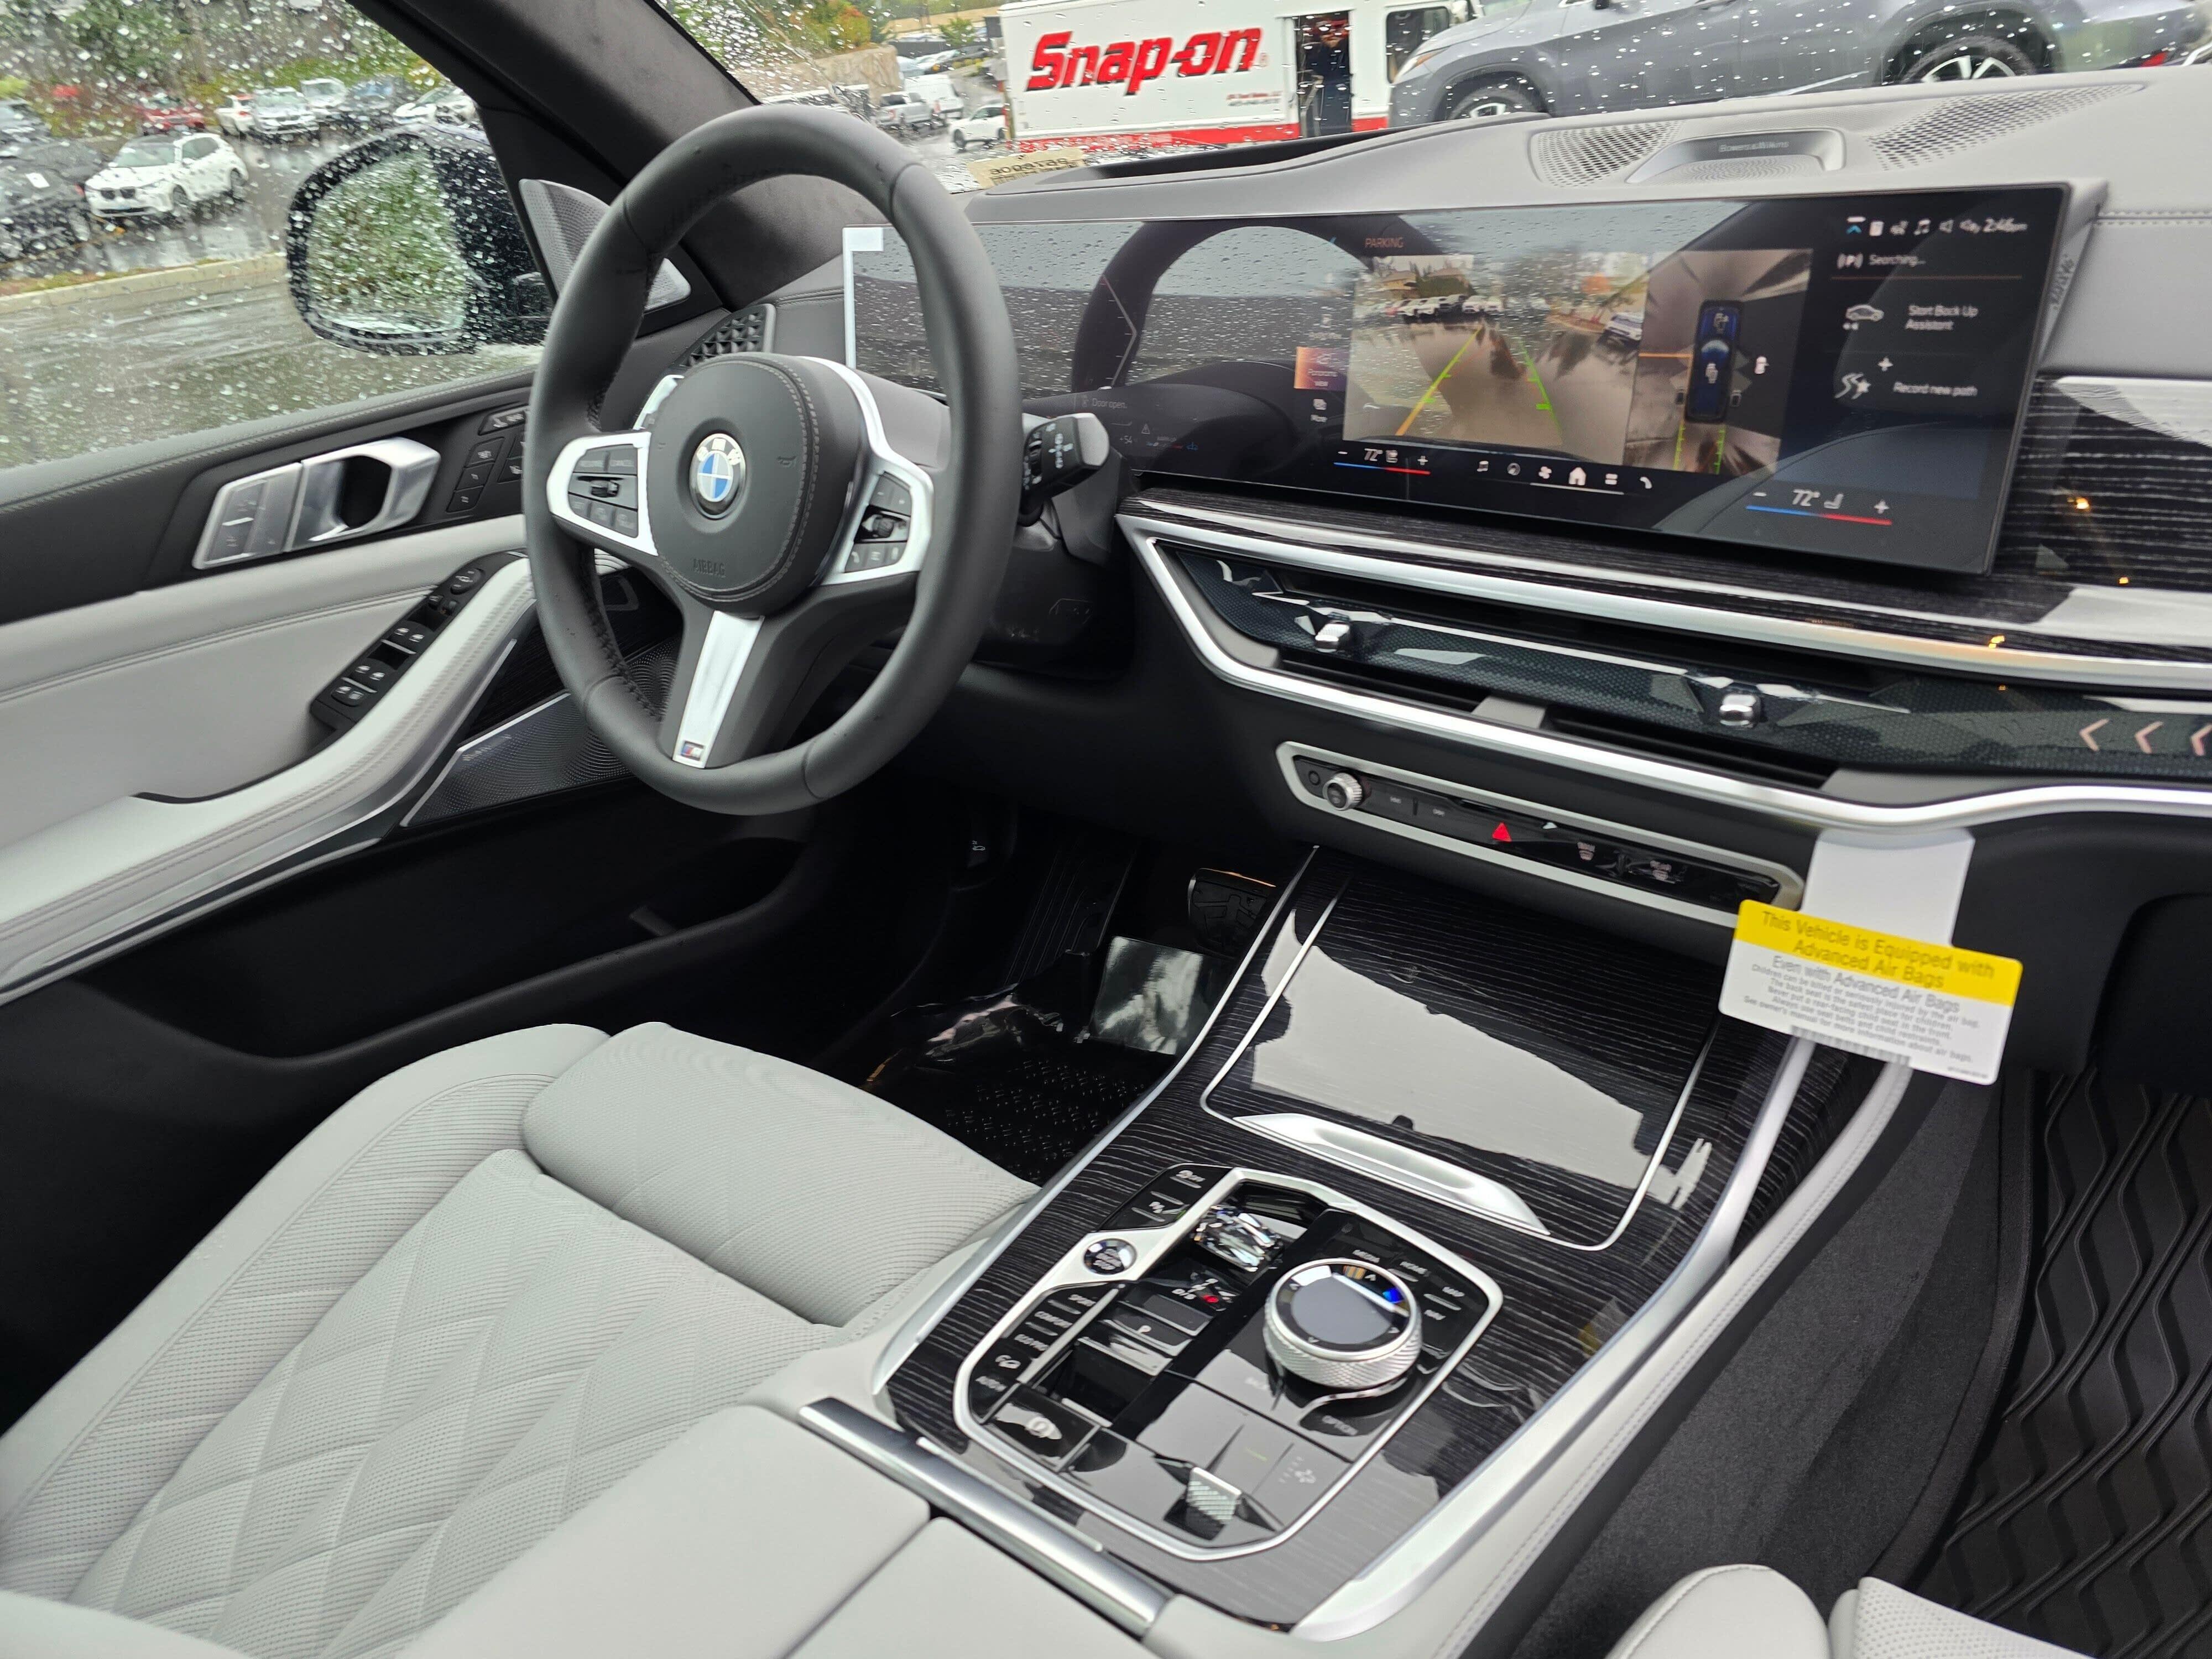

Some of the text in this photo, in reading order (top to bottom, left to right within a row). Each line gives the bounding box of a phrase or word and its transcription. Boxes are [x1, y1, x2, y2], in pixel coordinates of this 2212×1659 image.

[1024, 27, 1262, 96] Snap-on
[1364, 236, 1404, 248] PARKING
[1760, 910, 1792, 932] This
[1794, 919, 1850, 946] Vehicle
[1874, 938, 1952, 973] Equipped
[1956, 956, 1995, 979] with
[1793, 938, 1945, 992] Advanced Air Bags
[1772, 954, 1960, 1016] Even with Advanced Air Bags
